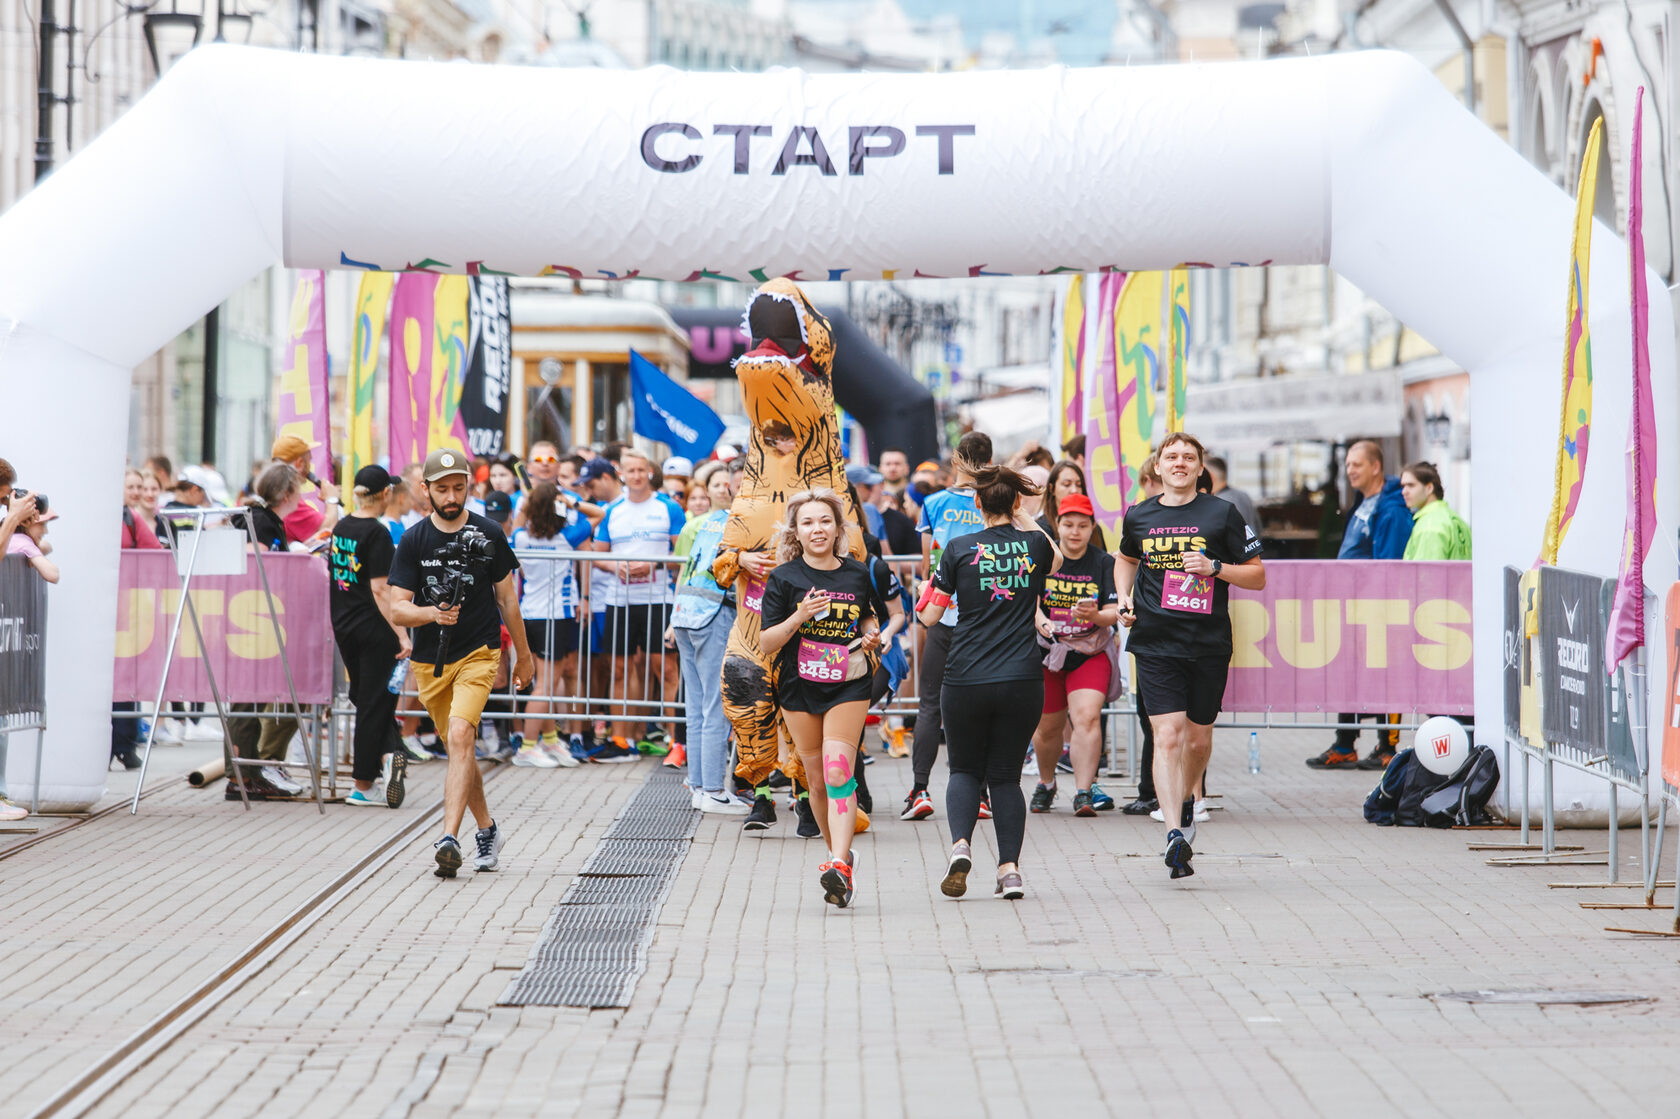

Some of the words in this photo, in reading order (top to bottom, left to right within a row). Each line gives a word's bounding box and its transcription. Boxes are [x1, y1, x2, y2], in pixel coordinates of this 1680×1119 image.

[640, 122, 976, 176] СТАРТ
[479, 276, 501, 414] RECO
[943, 509, 985, 526] СУДЬ
[1148, 526, 1199, 535] ARTEZIO
[332, 536, 358, 554] RUN
[978, 541, 1029, 557] RUN
[1142, 536, 1207, 553] RUTS
[1244, 540, 1261, 553] ARTE
[979, 557, 1030, 574] RUN
[980, 574, 1030, 591] RUN
[1045, 578, 1099, 595] RUTS
[804, 591, 855, 601] TEZIO
[1166, 594, 1208, 610] 3461
[797, 602, 860, 621] TS
[114, 588, 287, 660] UTS
[1228, 598, 1473, 671] RUTS
[799, 661, 843, 681] 3458
[1435, 738, 1449, 756] W
